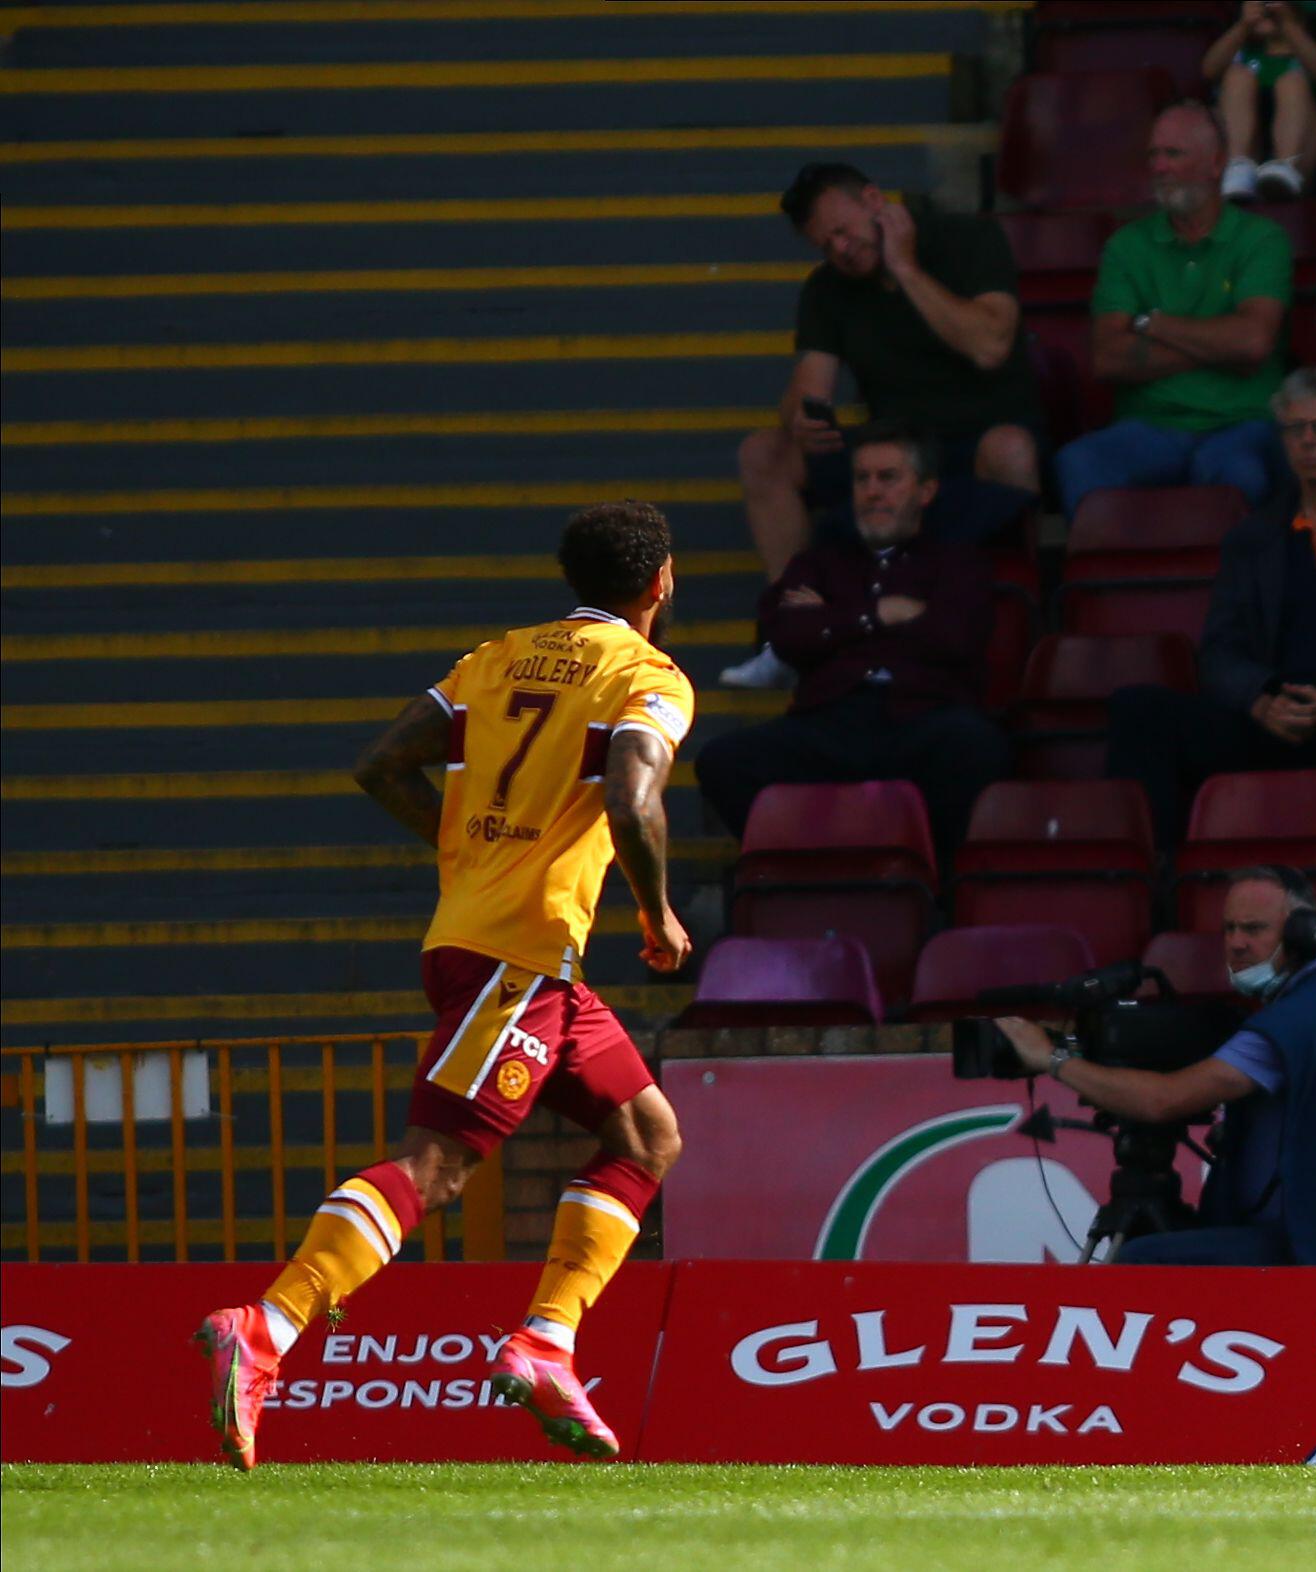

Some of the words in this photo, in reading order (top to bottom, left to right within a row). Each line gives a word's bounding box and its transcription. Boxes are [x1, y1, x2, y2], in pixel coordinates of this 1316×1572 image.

[488, 687, 560, 811] 7
[508, 1025, 550, 1066] TCL
[321, 1333, 512, 1363] ENJOY
[729, 1303, 1287, 1394] GLEN'S
[869, 1401, 1125, 1434] VODKA
